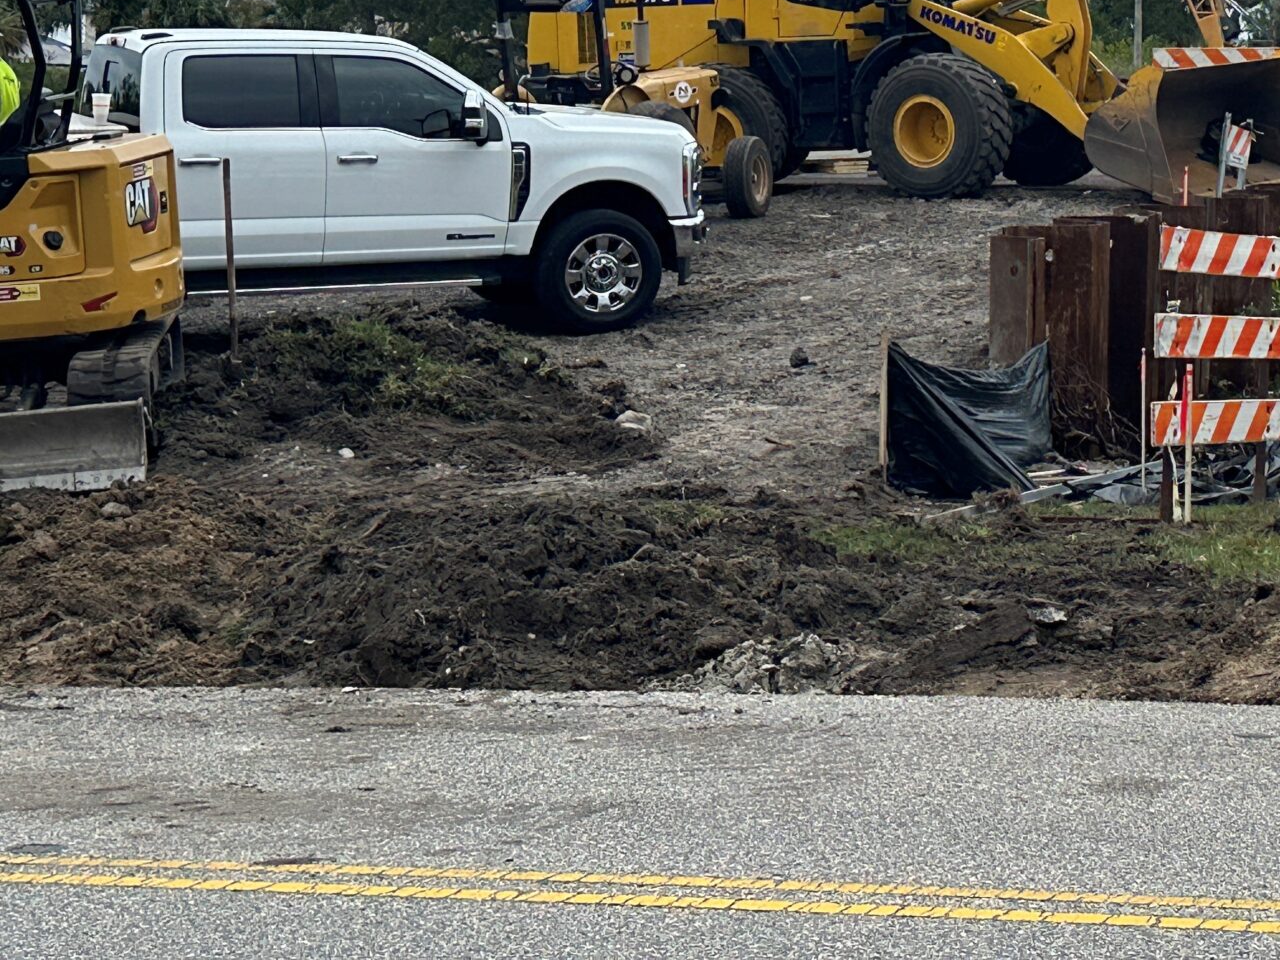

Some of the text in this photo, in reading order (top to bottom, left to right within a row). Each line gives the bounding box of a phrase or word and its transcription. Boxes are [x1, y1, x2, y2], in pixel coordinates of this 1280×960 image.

[919, 5, 997, 45] KOMATSU
[125, 179, 151, 226] CAT
[0, 236, 17, 251] AT
